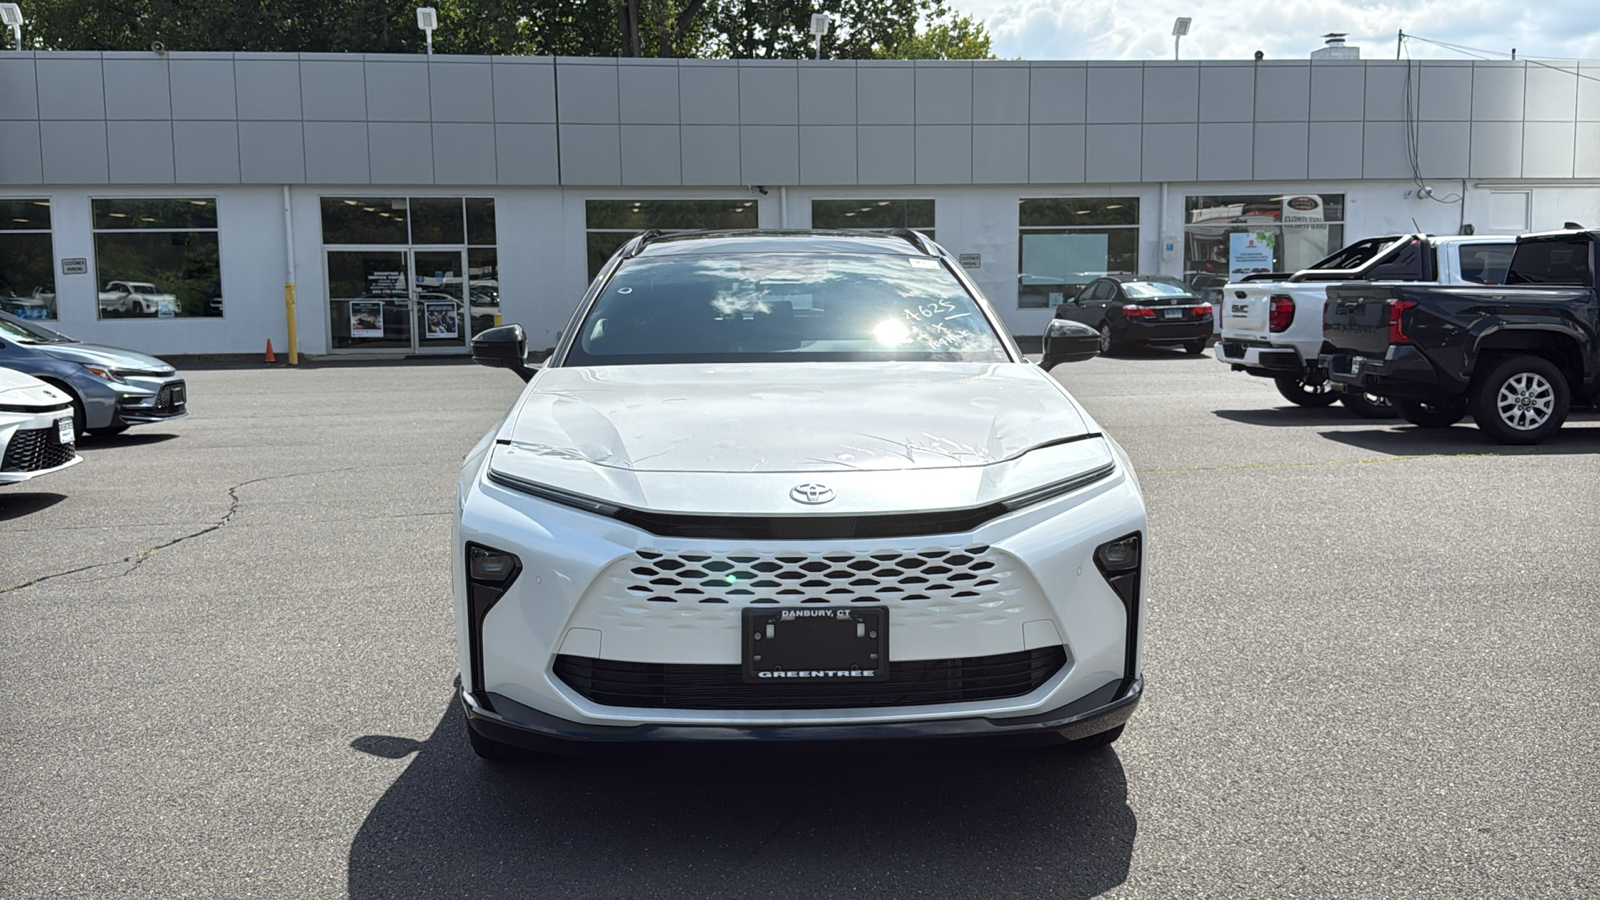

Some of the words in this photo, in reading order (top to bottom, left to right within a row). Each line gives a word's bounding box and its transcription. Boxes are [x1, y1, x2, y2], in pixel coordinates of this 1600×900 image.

[904, 299, 956, 321] 4625
[1231, 304, 1249, 313] GMC
[781, 610, 834, 618] DANBURY,
[836, 609, 851, 617] CT
